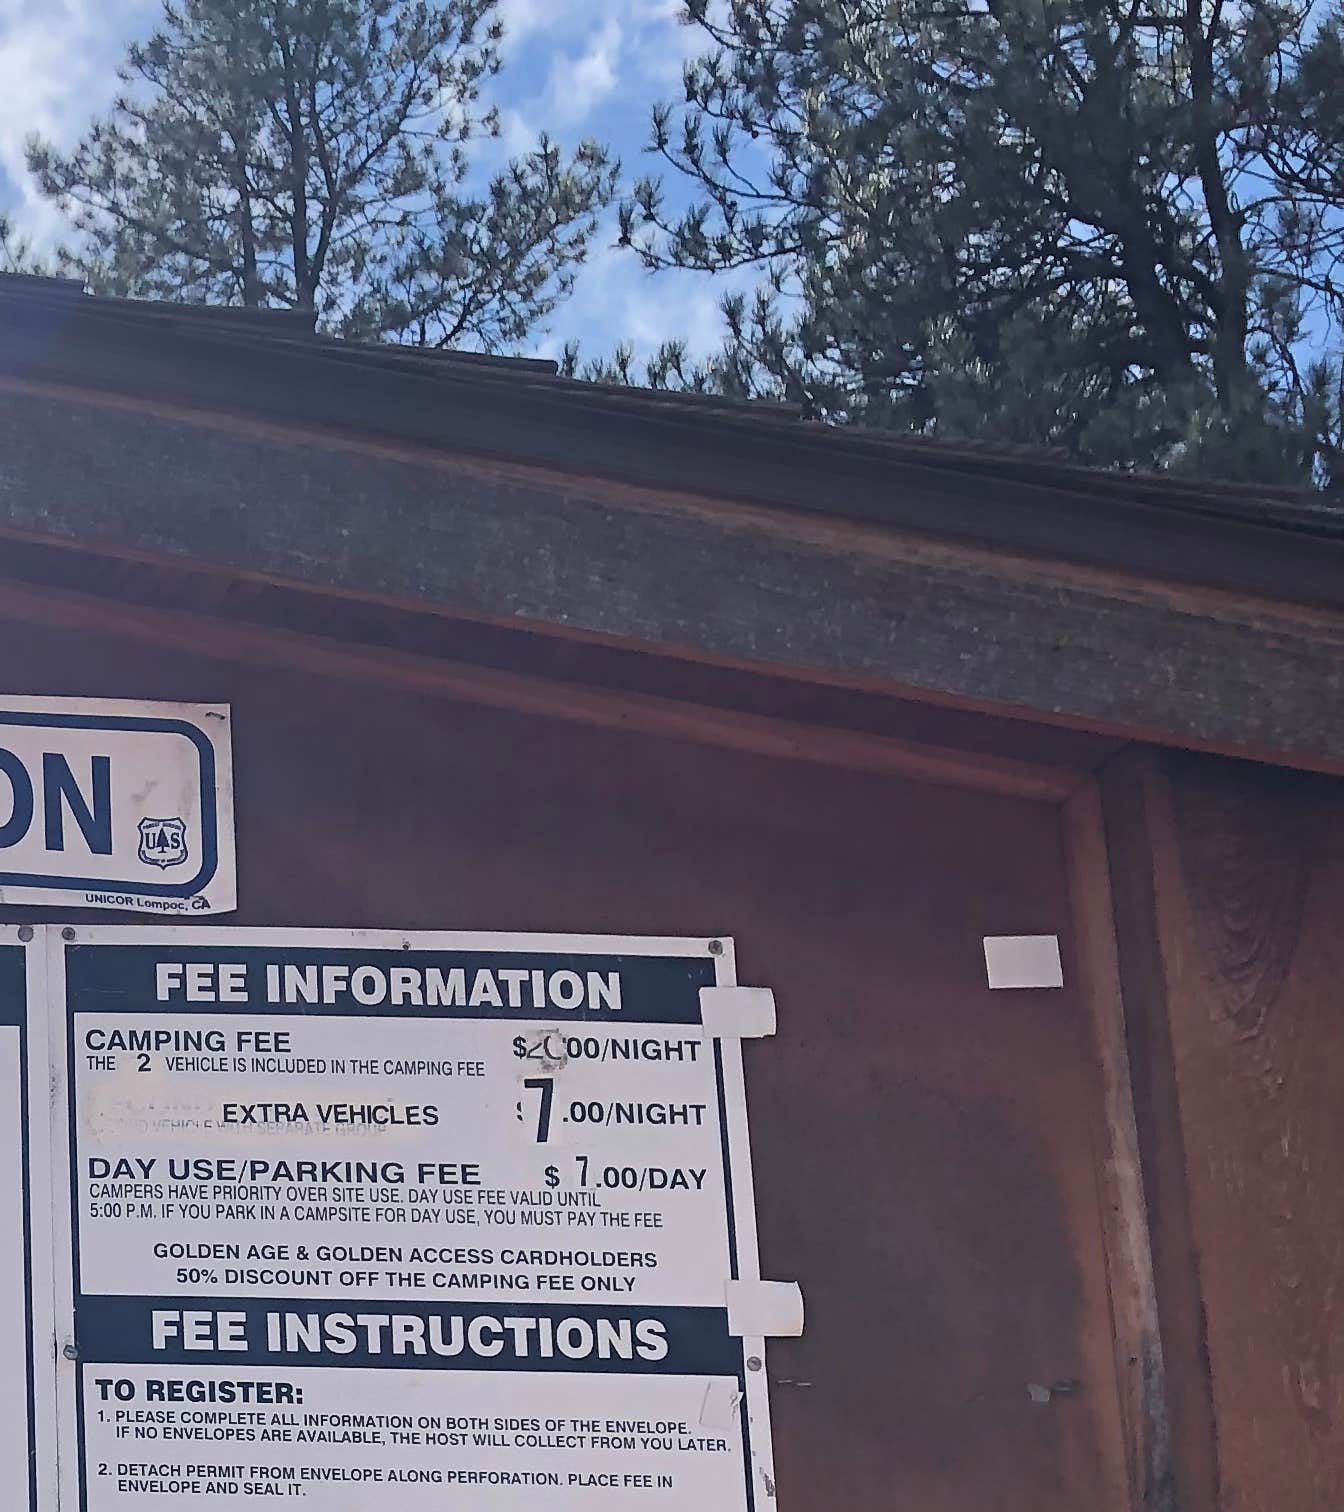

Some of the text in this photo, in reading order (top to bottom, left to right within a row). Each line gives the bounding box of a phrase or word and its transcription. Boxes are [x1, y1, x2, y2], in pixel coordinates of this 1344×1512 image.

[85, 893, 210, 910] UNICOR Lompoc, CA
[156, 963, 621, 1009] FEE INFORMATION
[85, 1029, 291, 1052] CAMPING FEE
[89, 1157, 481, 1185] DAY USE/PARKING FEE
[151, 1310, 667, 1360] FEE INSTRUCTIONS
[95, 1378, 302, 1404] TO REGISTER:
